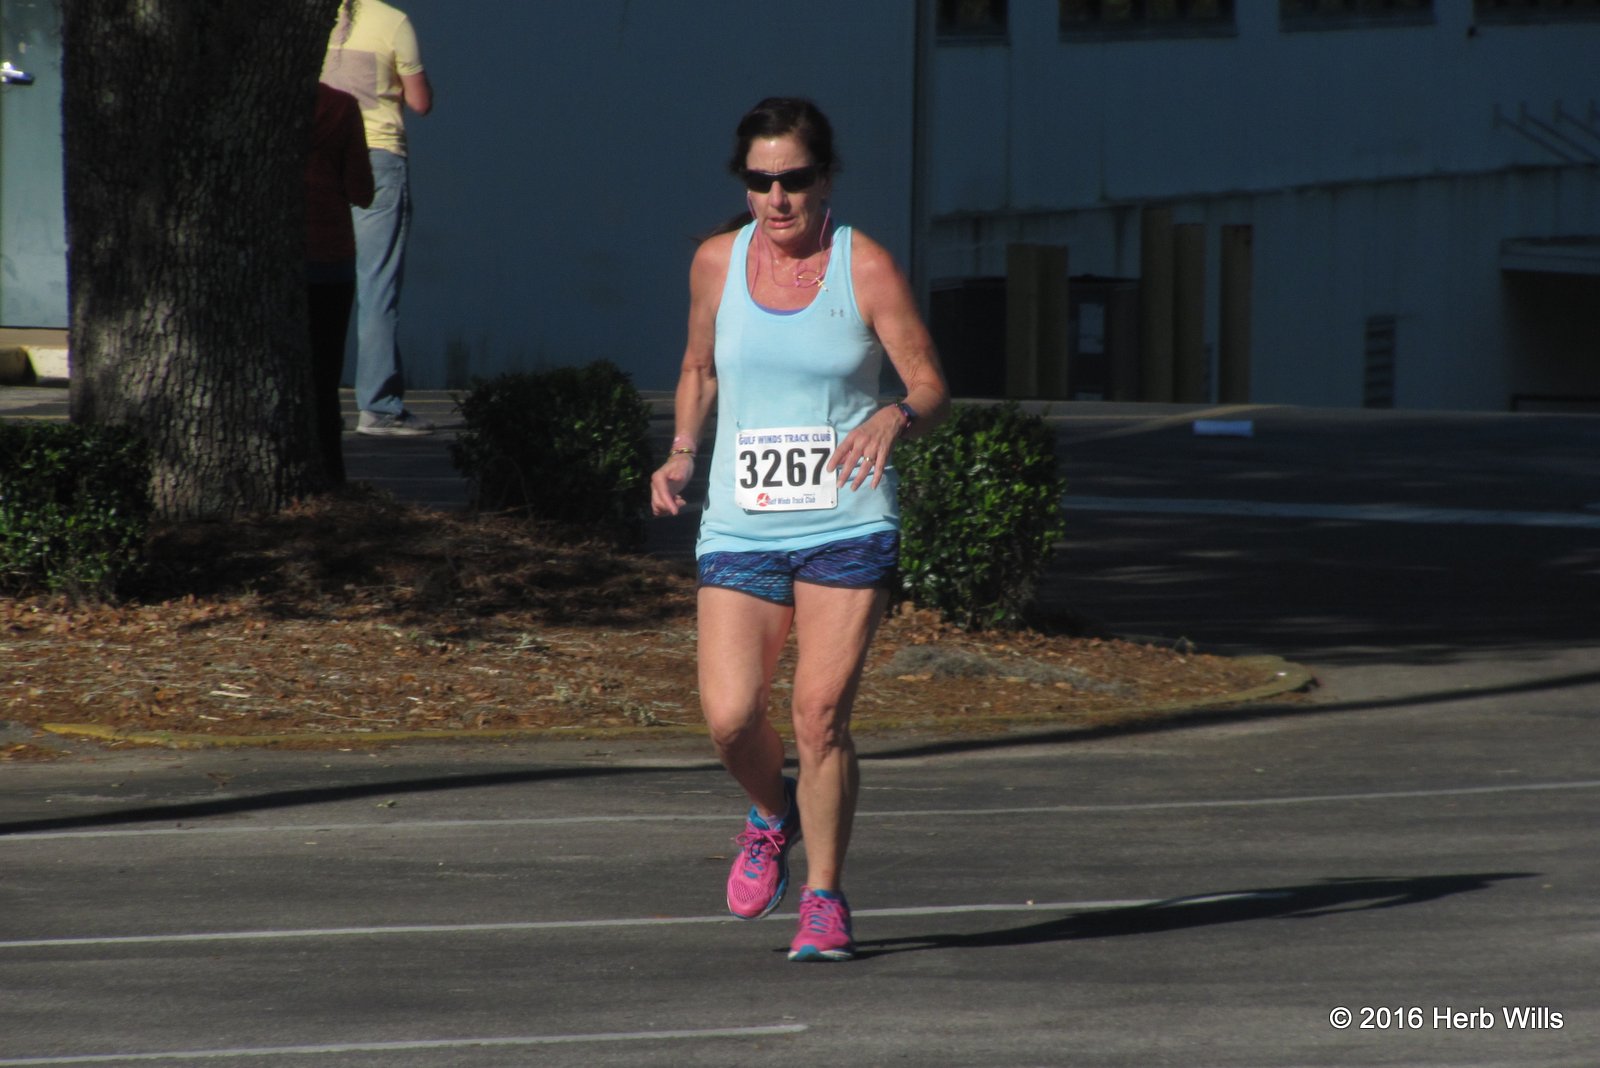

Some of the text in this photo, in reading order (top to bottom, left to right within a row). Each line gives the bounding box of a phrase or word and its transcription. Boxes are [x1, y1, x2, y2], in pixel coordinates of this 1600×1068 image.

[739, 433, 831, 445] GULF WINDS TRACK CLUB
[739, 448, 830, 489] 3267
